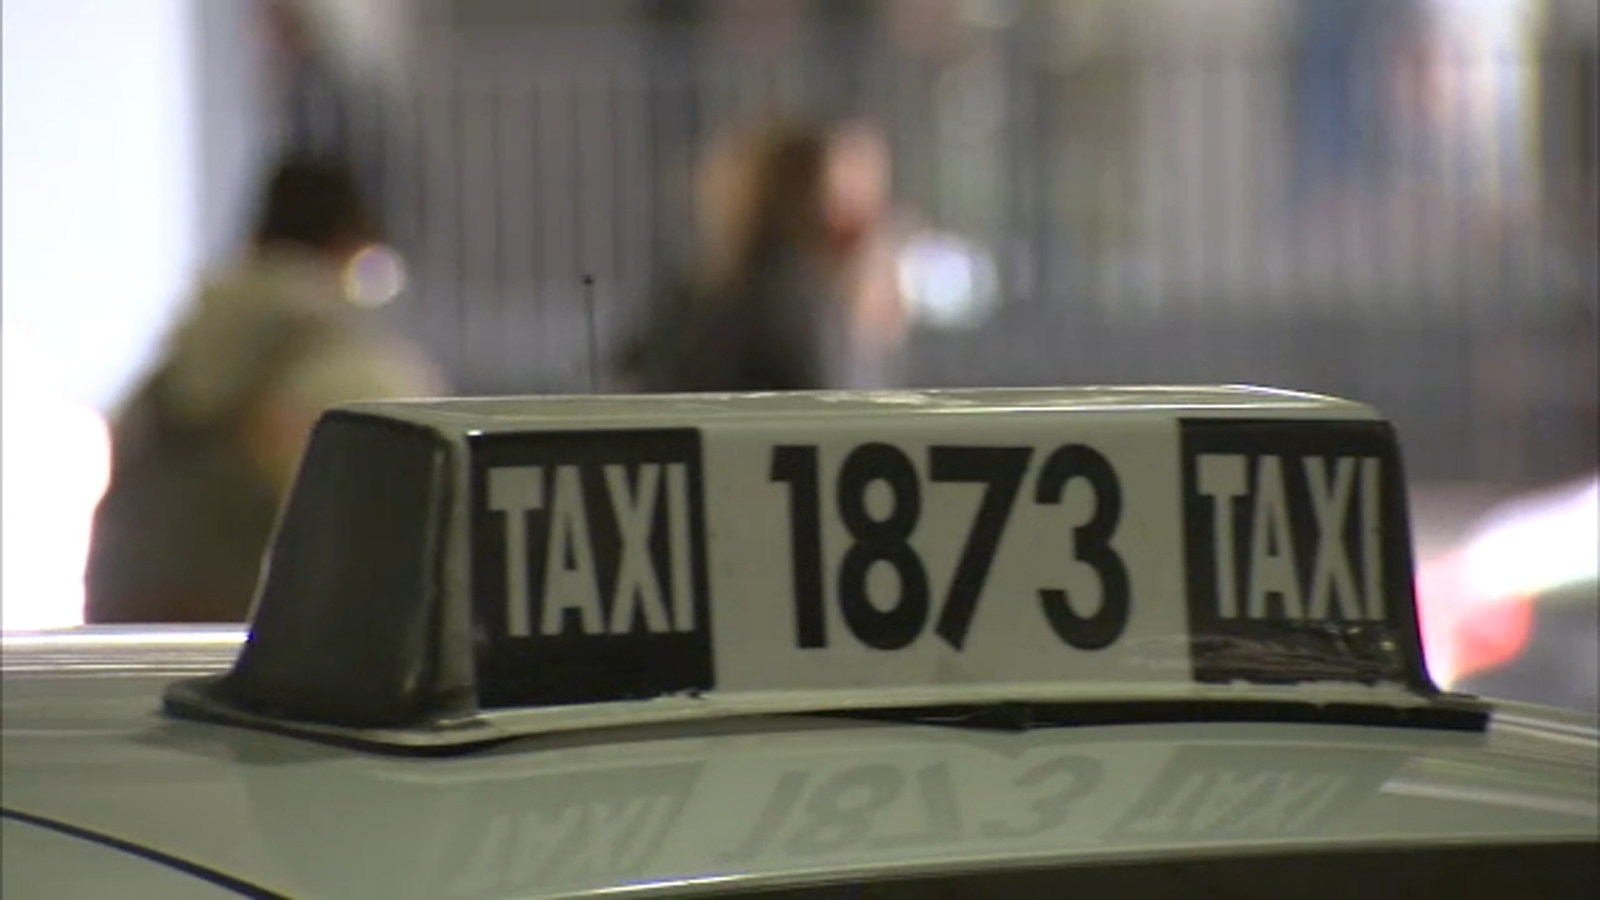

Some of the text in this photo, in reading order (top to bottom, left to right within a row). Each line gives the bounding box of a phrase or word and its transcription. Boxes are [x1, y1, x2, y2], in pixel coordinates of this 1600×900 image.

[486, 440, 1386, 651] TAXI 1873 TAXI
